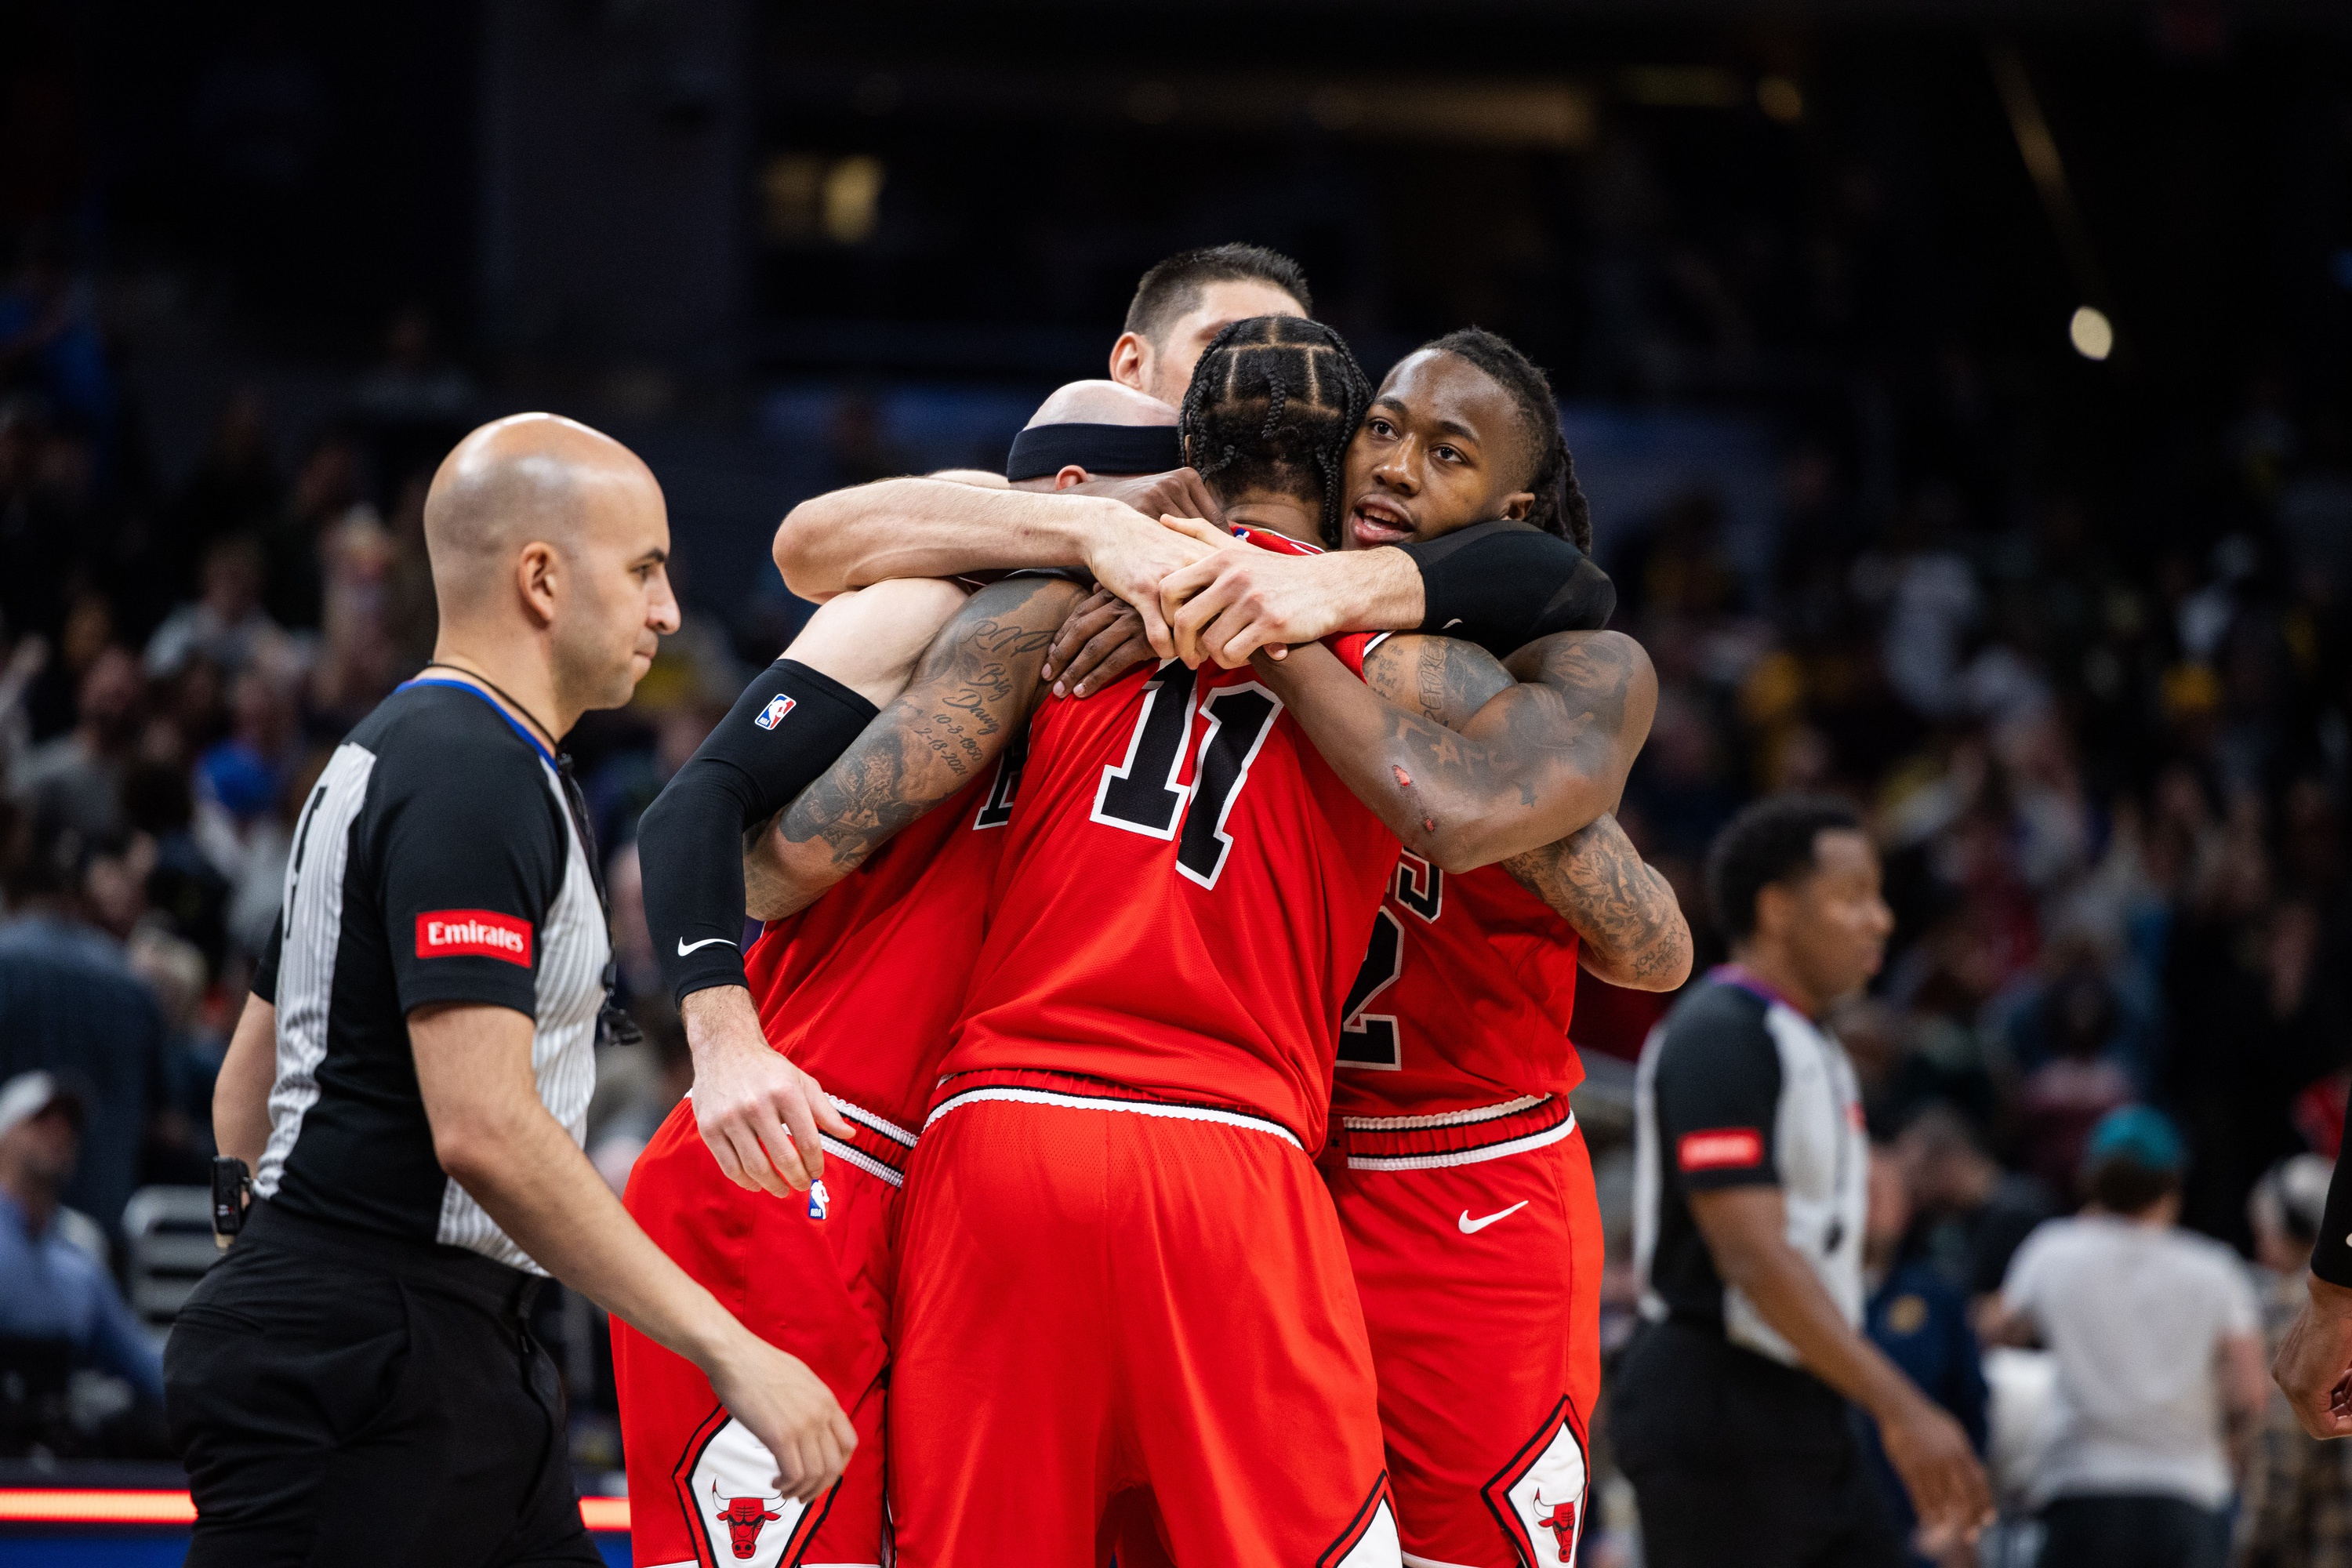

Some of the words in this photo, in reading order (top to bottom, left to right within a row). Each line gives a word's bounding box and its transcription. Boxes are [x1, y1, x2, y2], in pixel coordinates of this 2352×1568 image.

[965, 663, 1014, 702] Big
[1090, 656, 1284, 891] 11
[427, 919, 524, 953] Emirates
[810, 1207, 822, 1218] NBA
